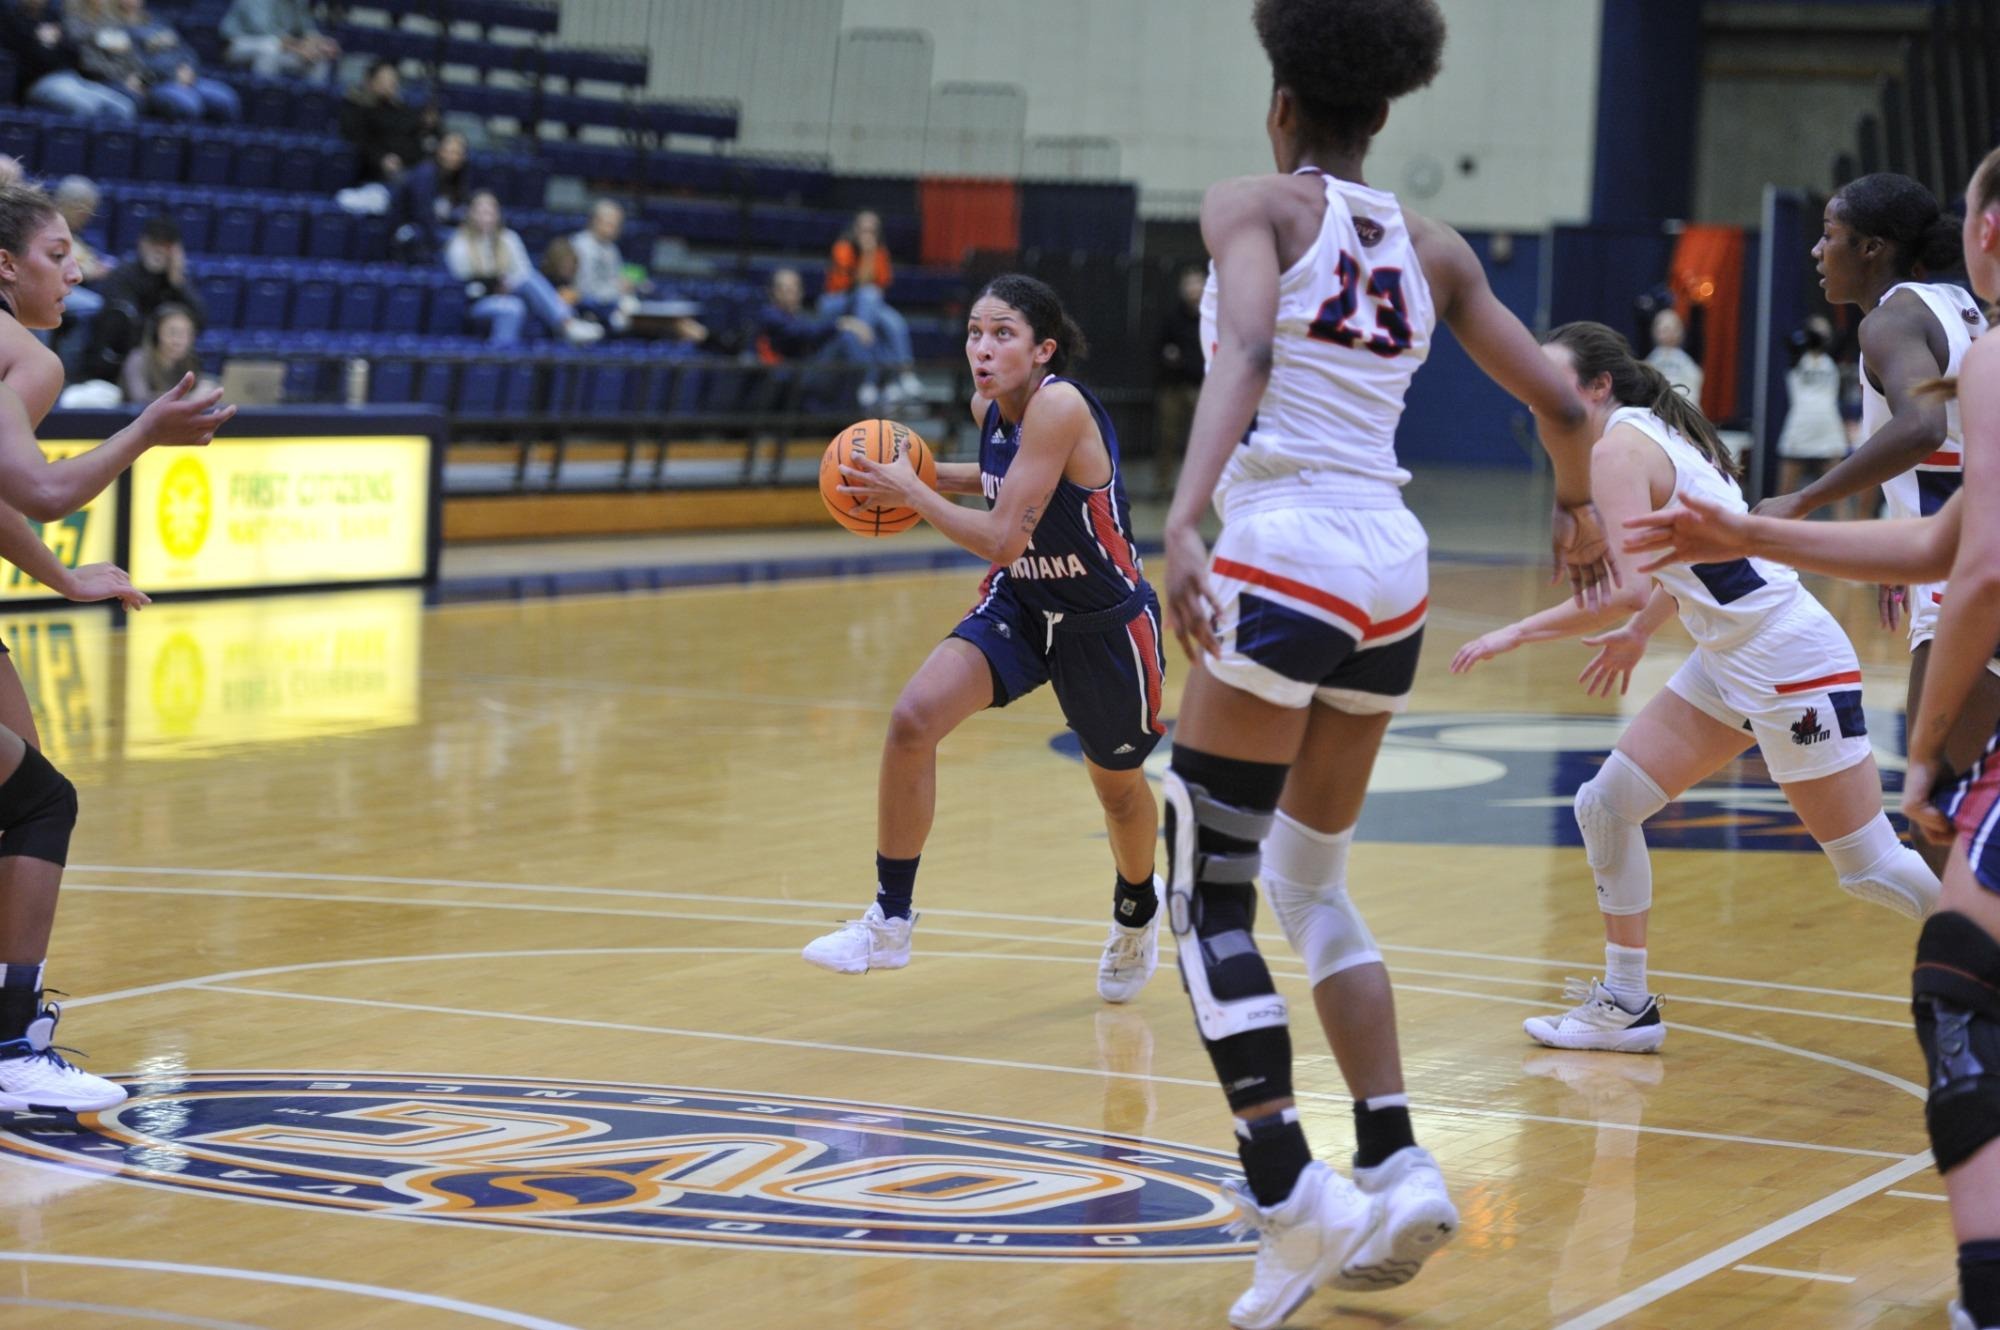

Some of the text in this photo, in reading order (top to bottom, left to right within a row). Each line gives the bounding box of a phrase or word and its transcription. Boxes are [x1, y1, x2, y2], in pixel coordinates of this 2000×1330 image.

[1306, 249, 1412, 358] 23
[13, 1110, 1142, 1245] OHIO VALEY
